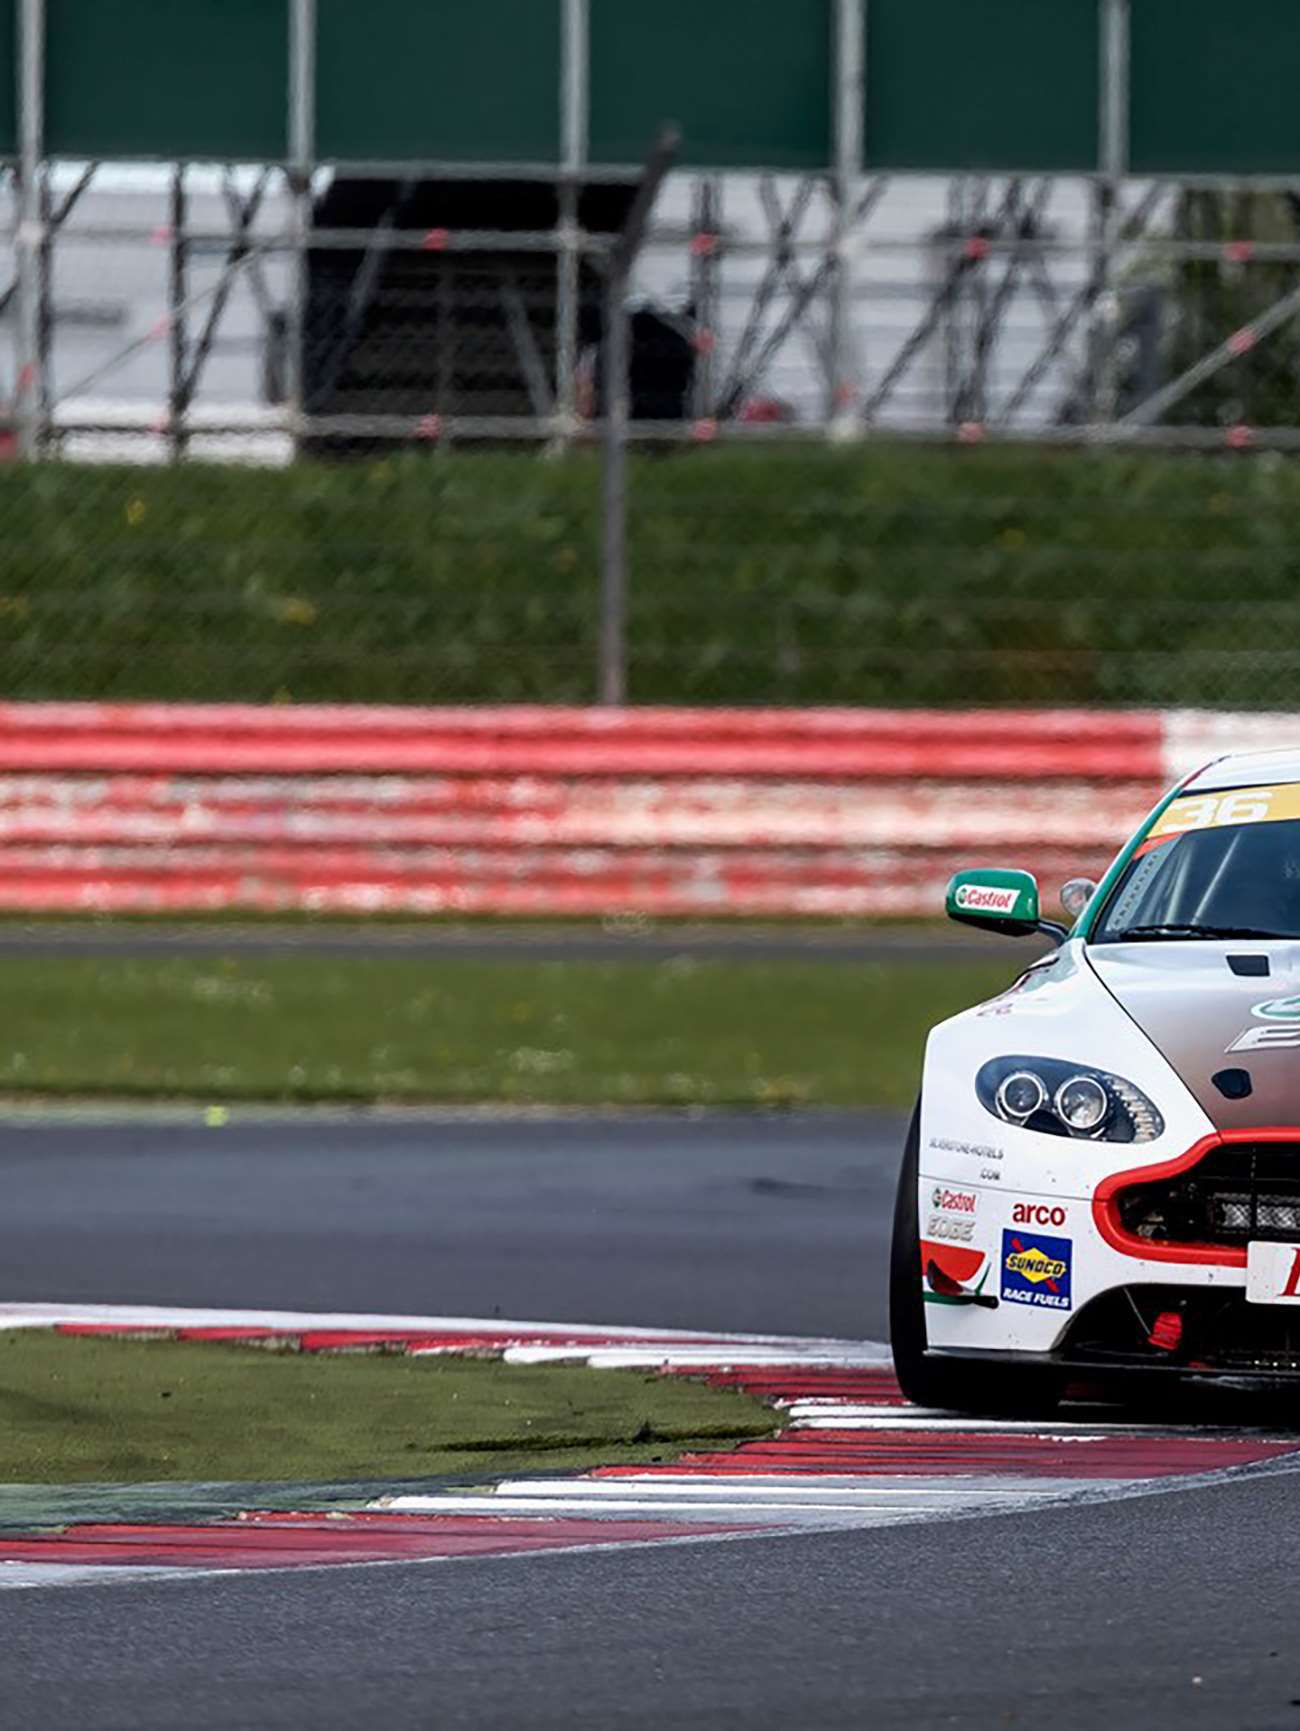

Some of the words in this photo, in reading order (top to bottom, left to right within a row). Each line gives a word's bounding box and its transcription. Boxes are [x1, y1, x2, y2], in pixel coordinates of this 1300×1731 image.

[1162, 792, 1273, 833] 36
[966, 888, 1013, 909] Castrol
[942, 1189, 977, 1213] Castrol
[1012, 1203, 1067, 1227] arco
[926, 1216, 977, 1243] EDGE
[1007, 1254, 1065, 1276] SUNOCO
[1003, 1286, 1034, 1303] RACE
[1033, 1293, 1070, 1308] FUELS
